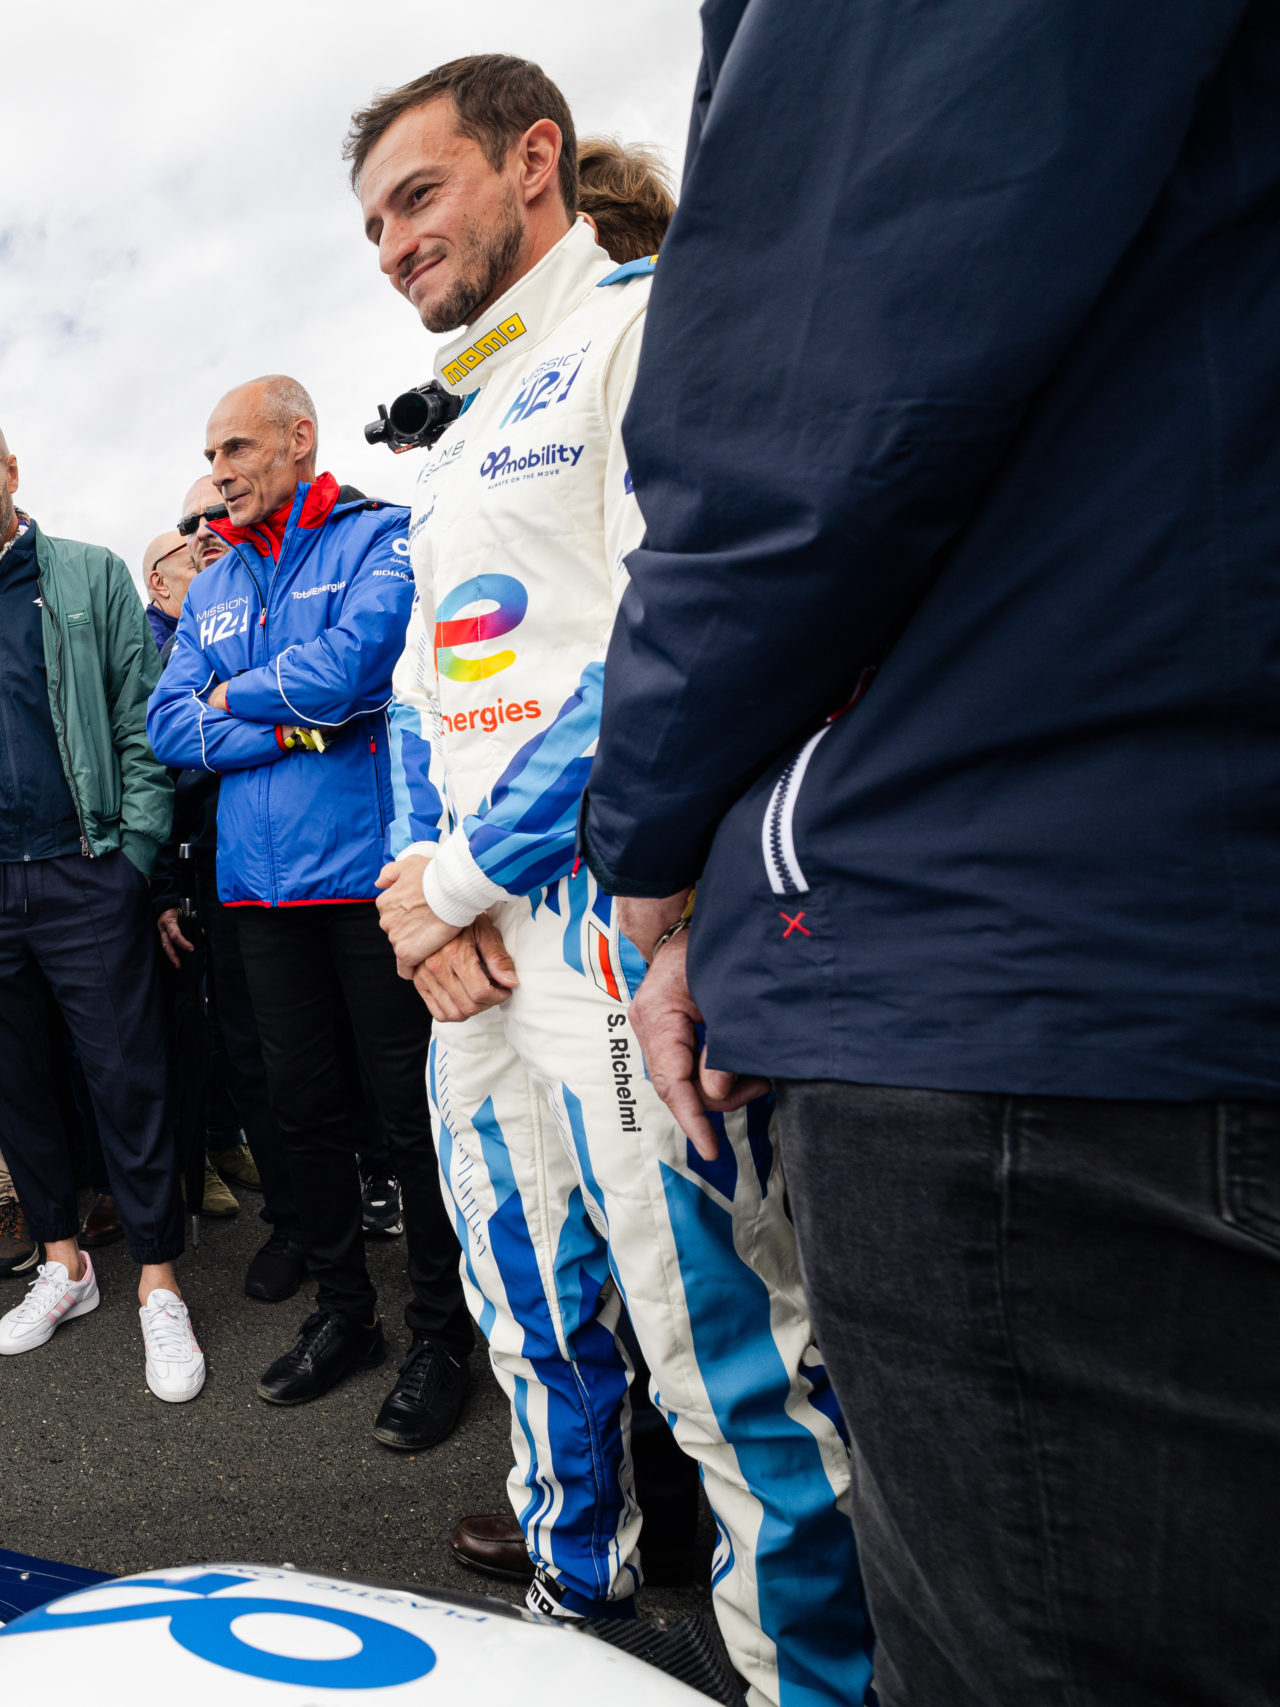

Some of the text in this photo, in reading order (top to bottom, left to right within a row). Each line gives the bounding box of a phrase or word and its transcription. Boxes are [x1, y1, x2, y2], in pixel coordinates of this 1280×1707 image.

[537, 469, 560, 477] MOVE
[196, 596, 248, 623] MISSION
[606, 1013, 642, 1134] S. Richelmi
[306, 1581, 488, 1624] PLASTIC
